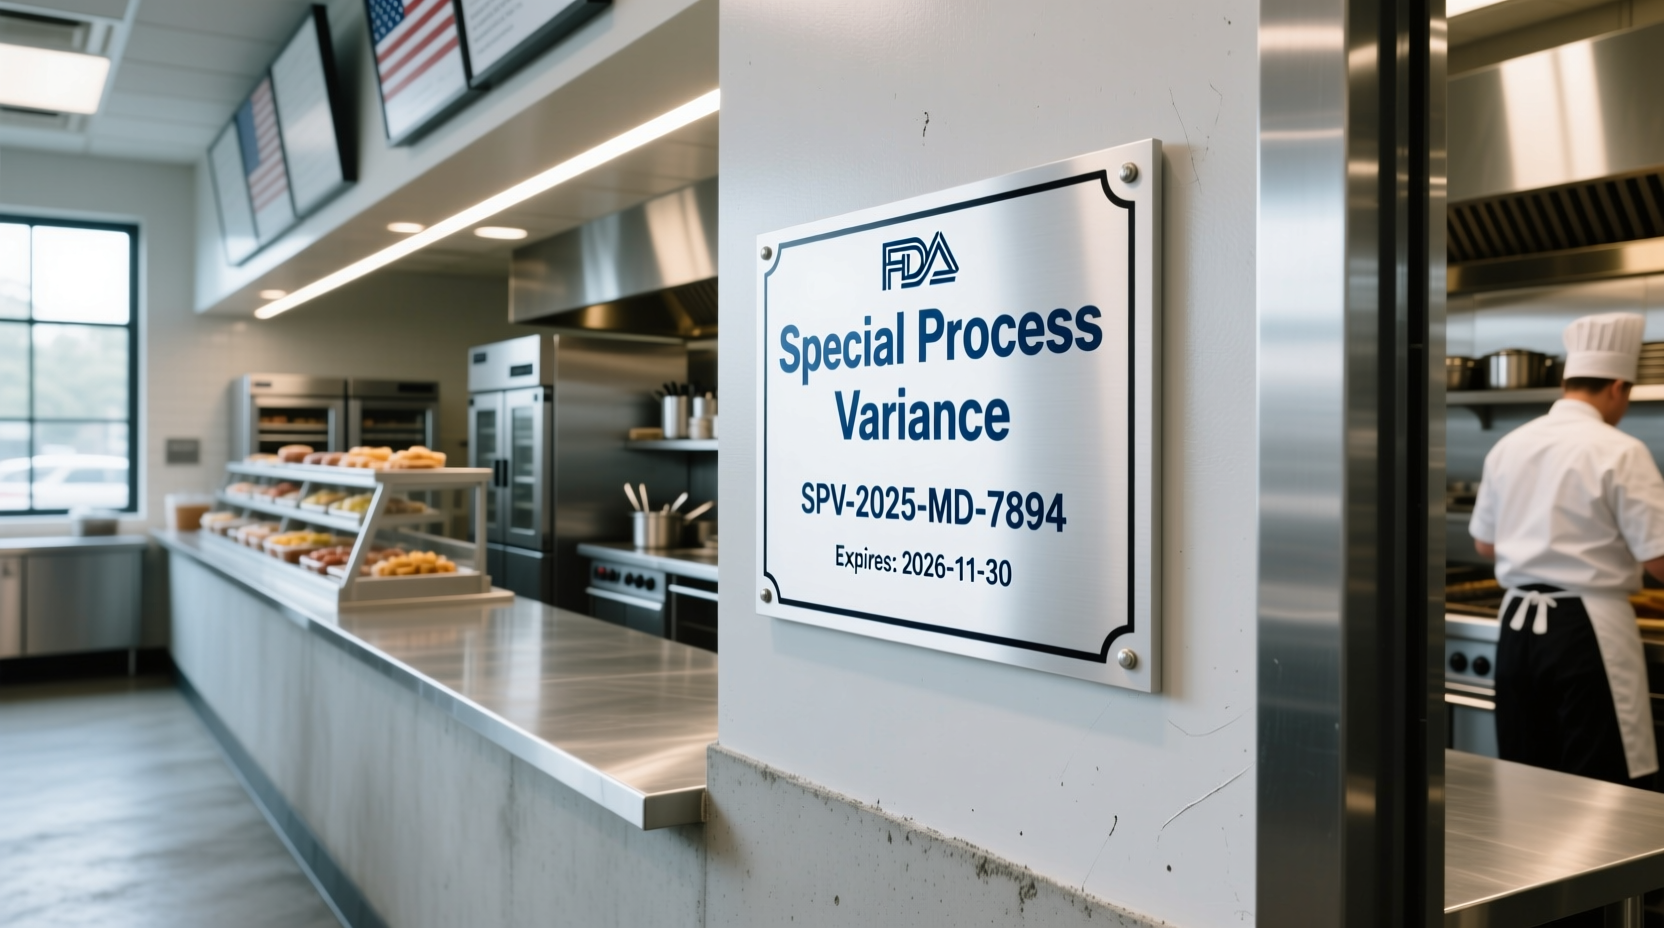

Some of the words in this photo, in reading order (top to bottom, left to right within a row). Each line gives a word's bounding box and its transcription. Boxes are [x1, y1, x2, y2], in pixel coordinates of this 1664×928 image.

[882, 231, 959, 291] FDA
[780, 311, 905, 386] Special
[919, 305, 1103, 363] Process
[835, 386, 1011, 442] Variance
[802, 481, 1067, 533] SPV-2025-MD-7894
[836, 544, 897, 575] Expires:
[902, 551, 1013, 588] 2026-11-30
